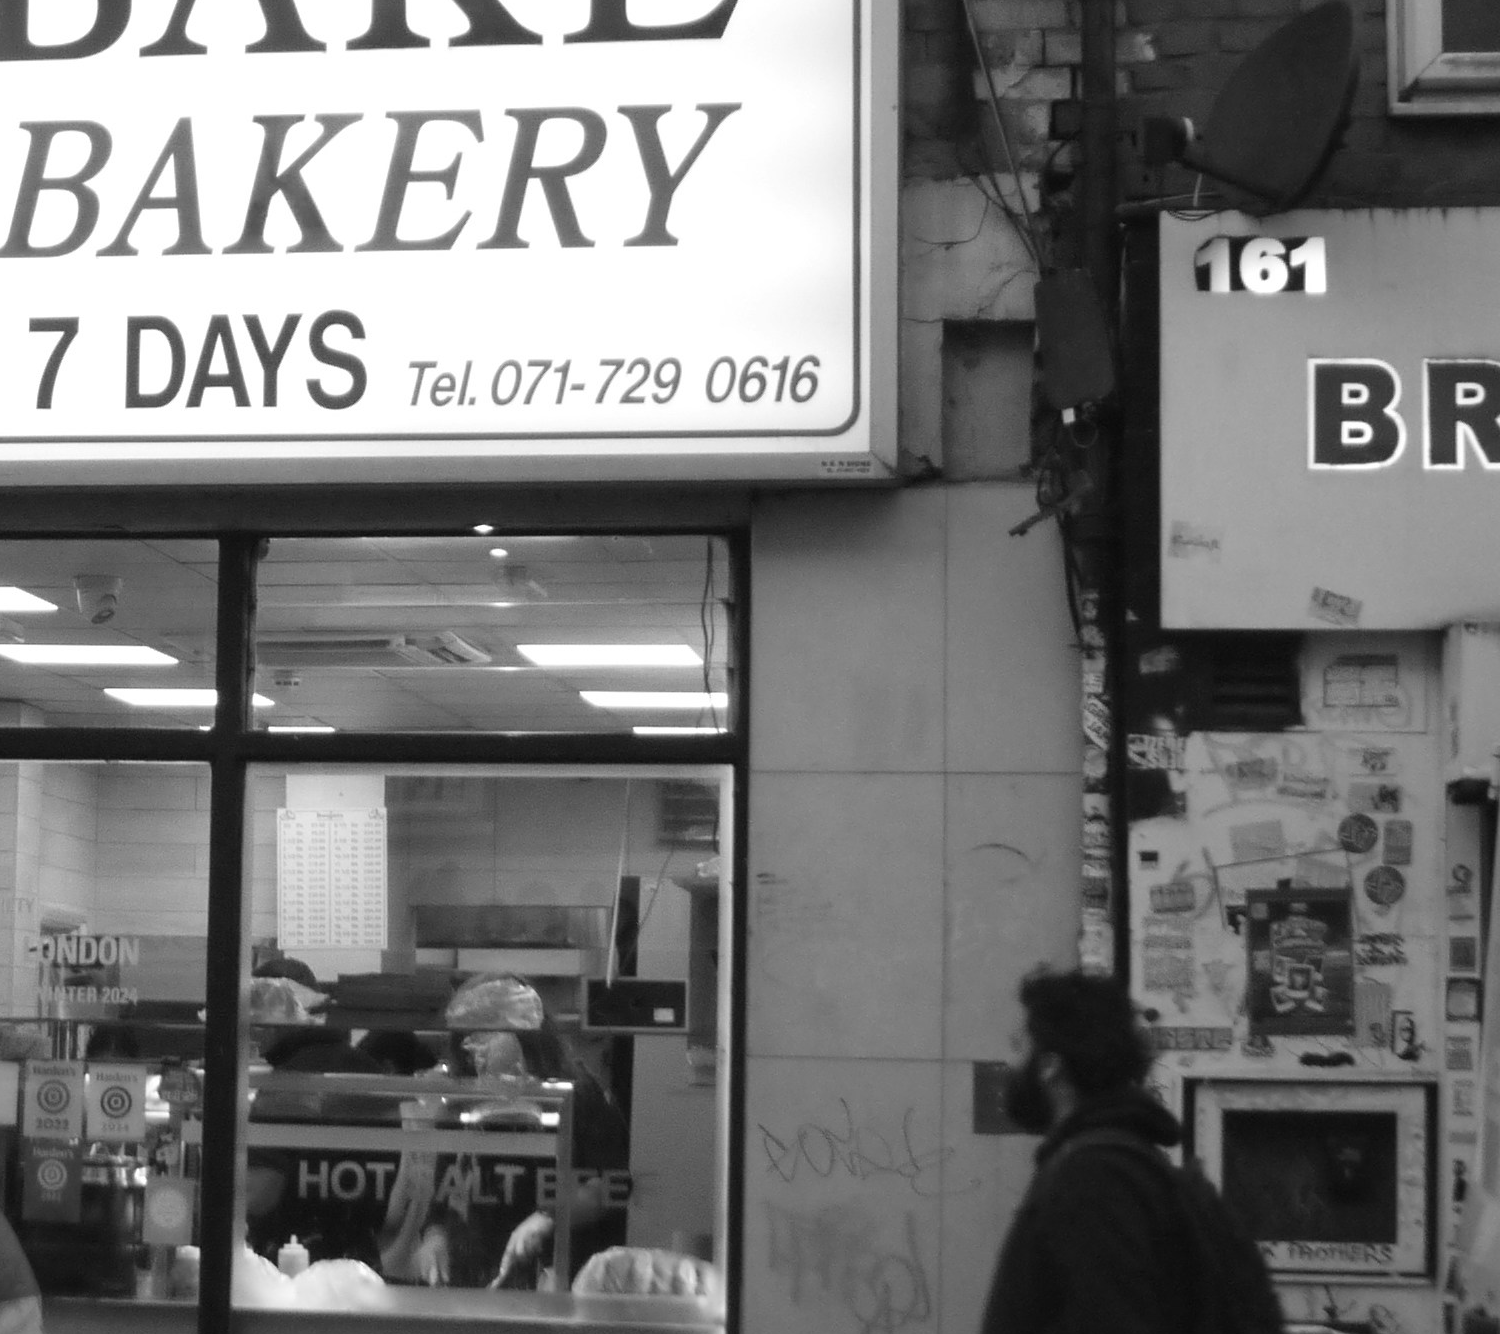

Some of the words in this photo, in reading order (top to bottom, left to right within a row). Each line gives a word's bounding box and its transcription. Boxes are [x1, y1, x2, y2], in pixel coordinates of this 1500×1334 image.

[1195, 236, 1327, 294] 161
[28, 317, 79, 410] 7
[125, 310, 368, 411] DAYS
[705, 355, 821, 404] 0616
[101, 986, 139, 1007] 2024
[297, 1160, 395, 1200] HOT
[408, 1163, 526, 1205] ALT
